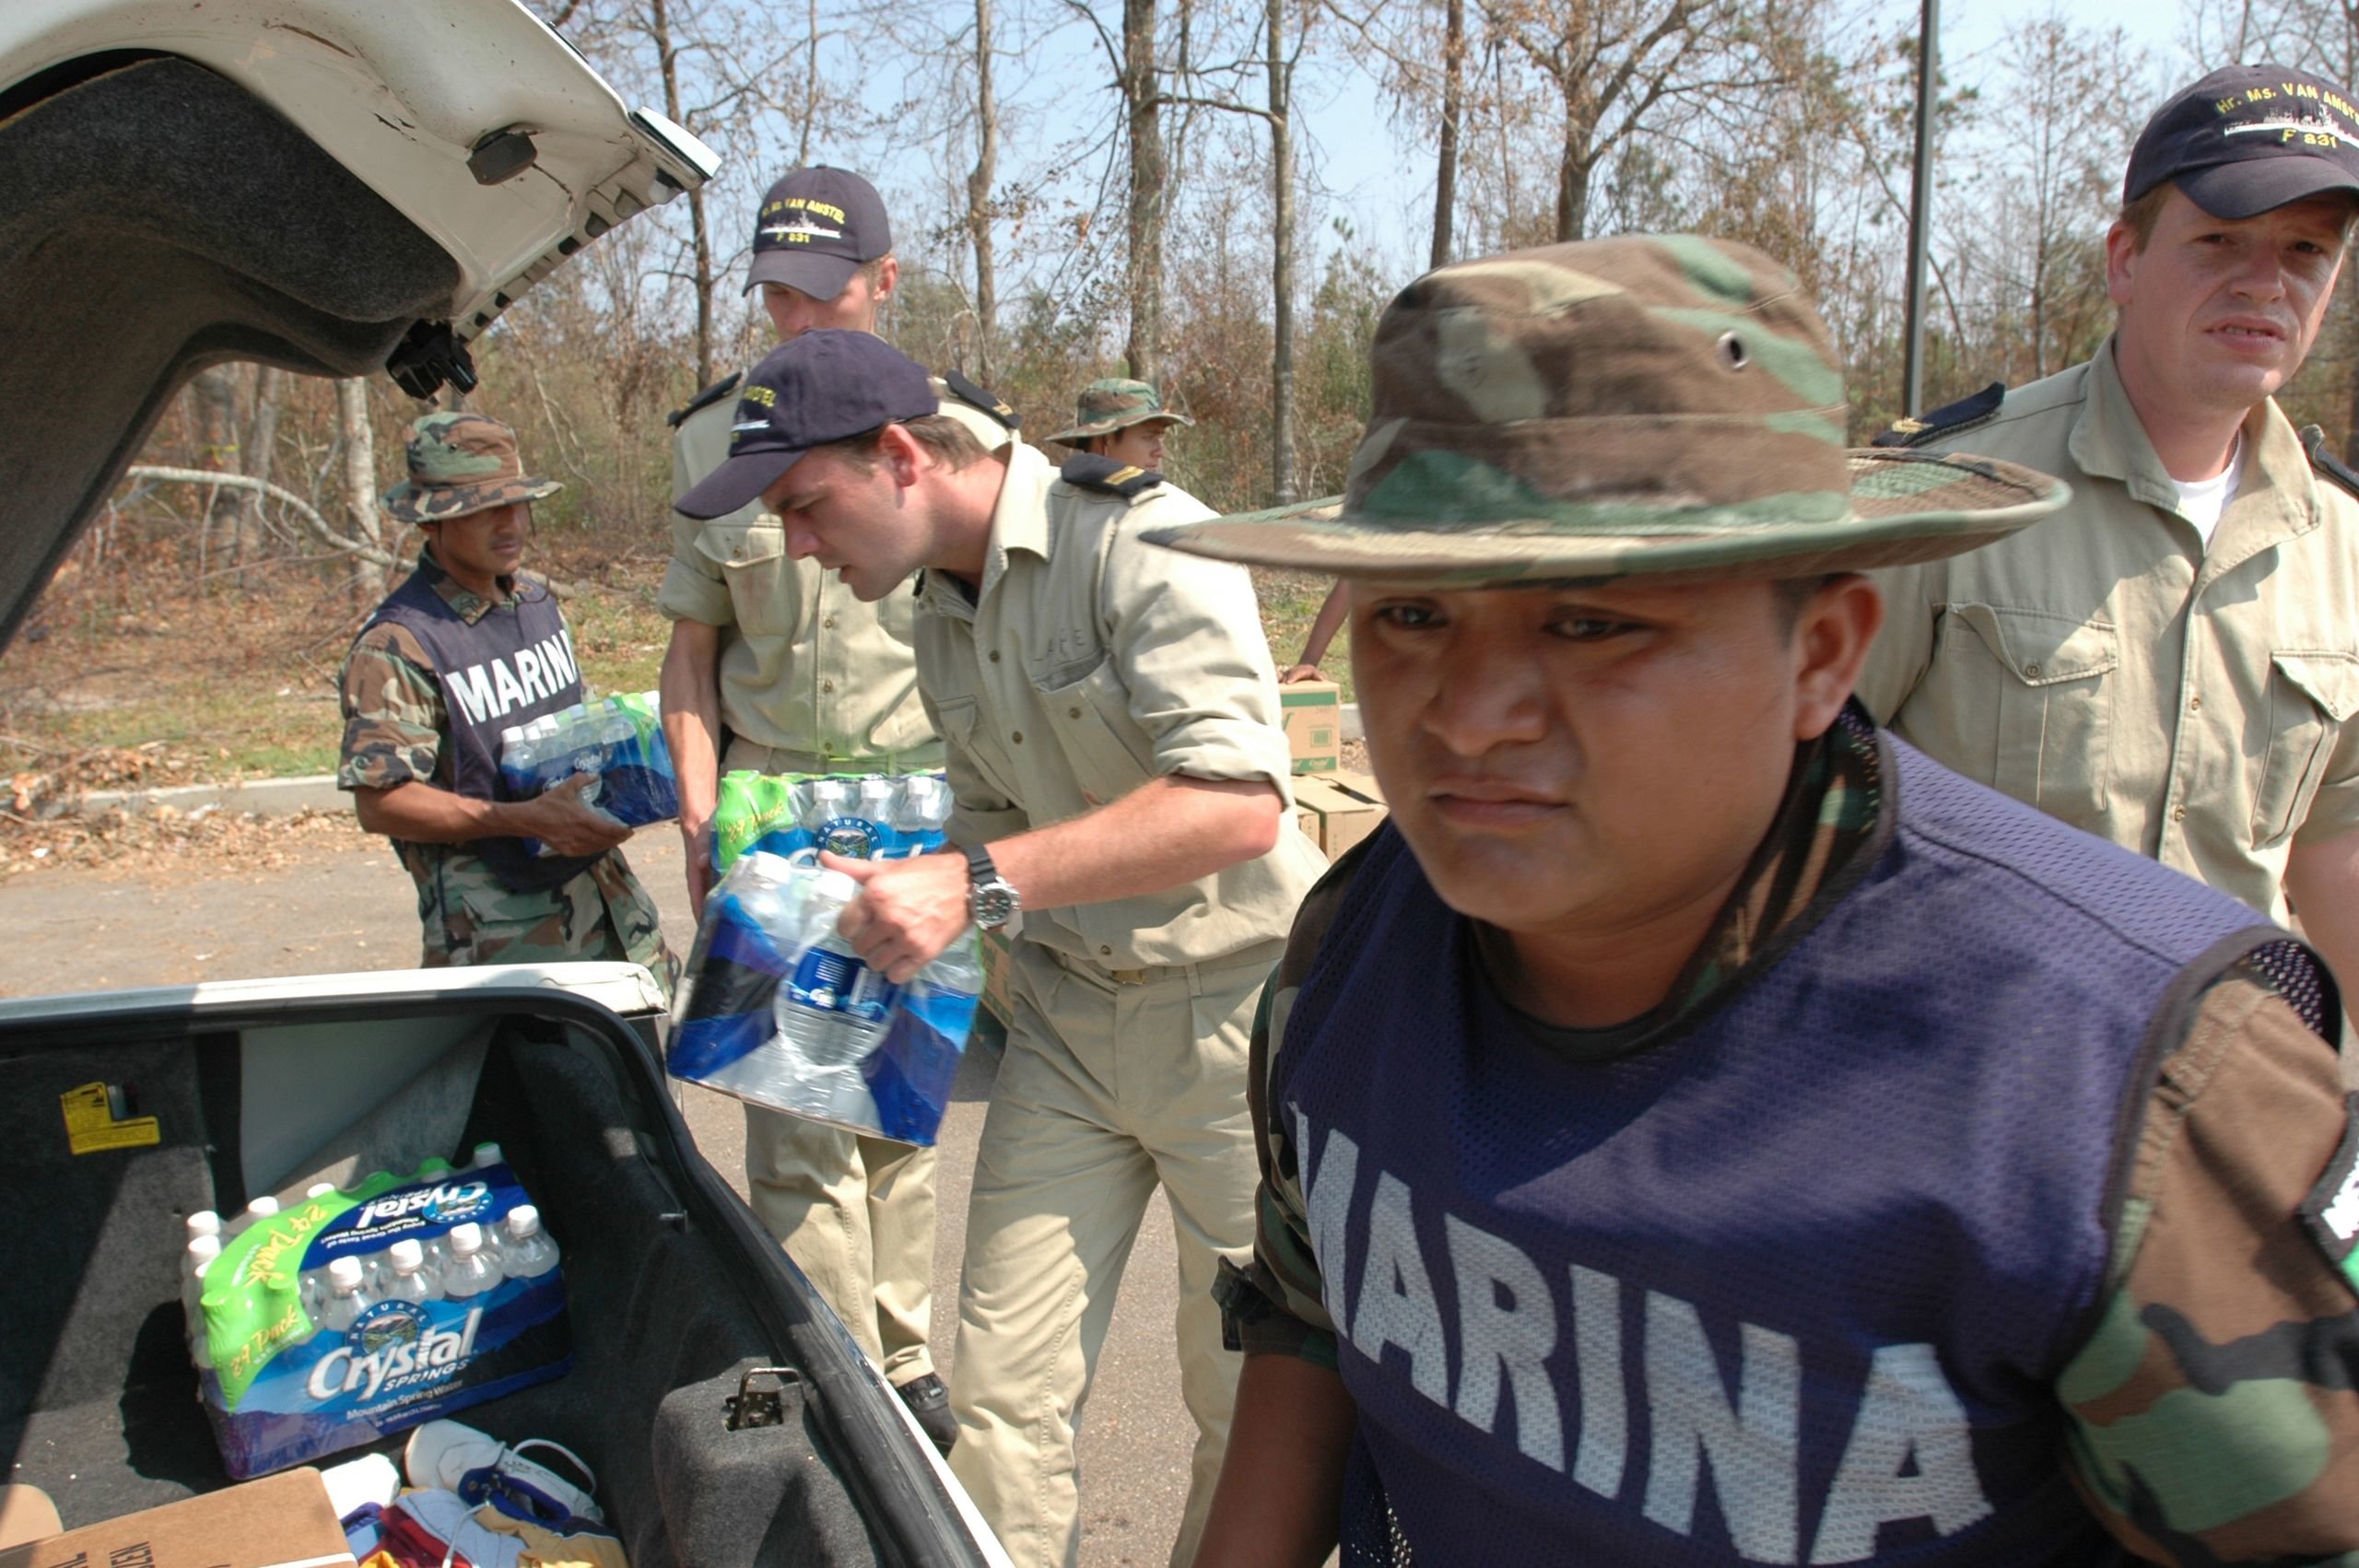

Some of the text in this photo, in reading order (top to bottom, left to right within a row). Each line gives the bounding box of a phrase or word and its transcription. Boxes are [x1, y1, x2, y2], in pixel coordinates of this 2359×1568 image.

[2215, 97, 2242, 114] Hr.
[2246, 87, 2276, 102] Ms.
[2282, 82, 2319, 99] VAN
[2282, 128, 2338, 148] F 831
[355, 1180, 488, 1229] Crystal
[349, 1302, 428, 1340] NATURAL
[1290, 1102, 1995, 1566] MARINA
[306, 1306, 484, 1401] Crystal
[383, 1358, 471, 1392] SPRINGS
[346, 1398, 398, 1421] Mountain
[397, 1387, 433, 1405] Spring
